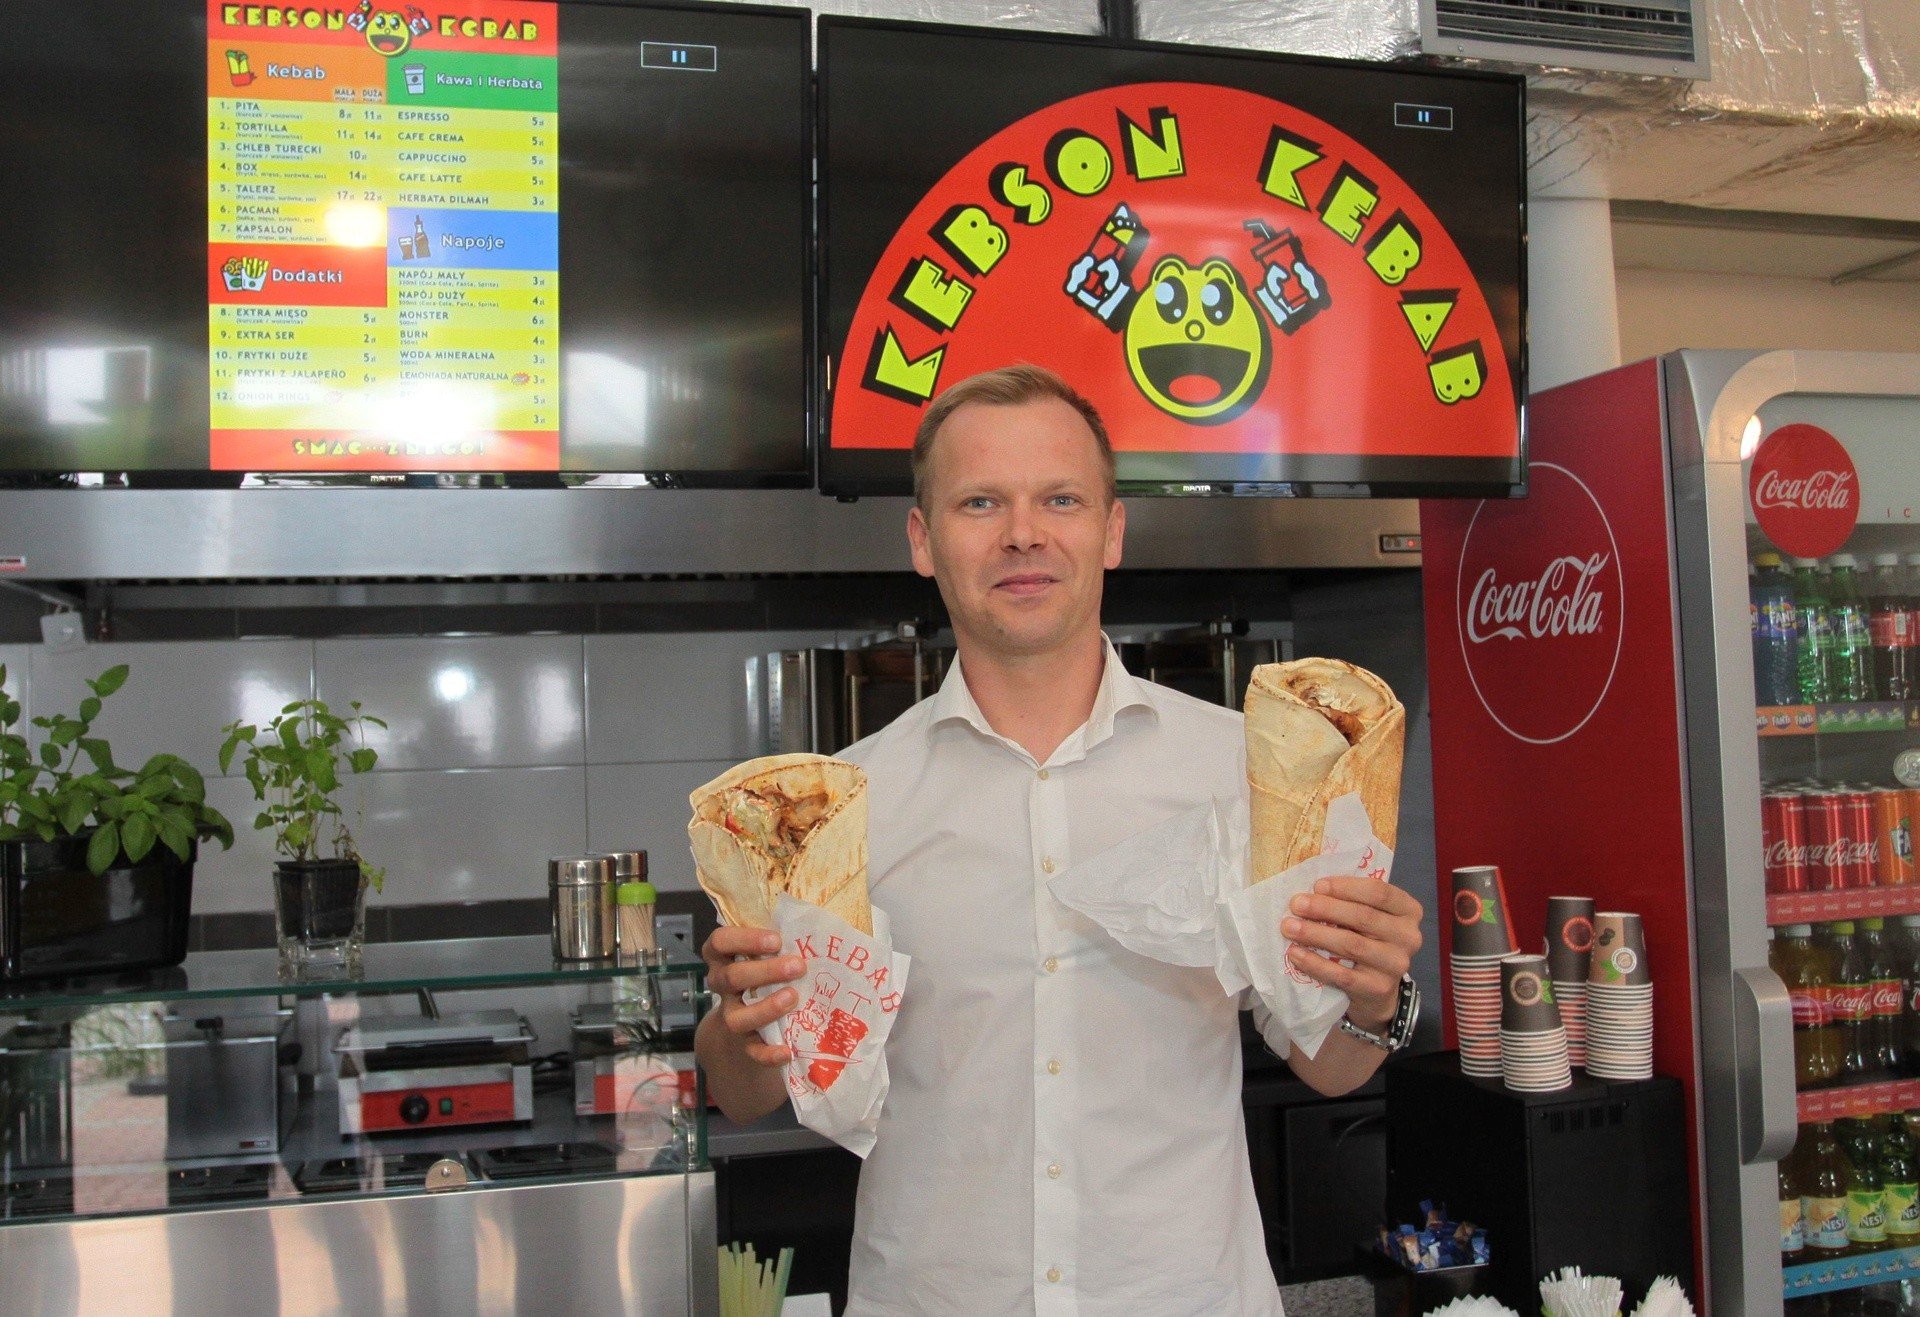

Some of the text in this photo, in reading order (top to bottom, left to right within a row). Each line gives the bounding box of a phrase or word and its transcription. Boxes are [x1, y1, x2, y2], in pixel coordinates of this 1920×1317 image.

[222, 3, 345, 31] KEBSON
[266, 63, 326, 80] Kebab
[436, 73, 543, 90] Kawa i Herbata
[220, 101, 260, 111] 1. PITA
[398, 111, 450, 122] ESPRESSO
[220, 121, 288, 132] 2. TORTILLA
[398, 132, 464, 143] CAFE CREMA
[220, 142, 322, 154] 3. CHLEB TURECKI
[398, 152, 467, 163] CAPPUCCINO
[220, 162, 257, 171] 4. BOX
[398, 173, 462, 183] CAFE LATTE
[220, 183, 275, 193] 5. TALERZ
[399, 194, 489, 204] HERBATA DILMAH
[220, 204, 280, 215] 6. PACMAN
[220, 223, 293, 233] 7. KAPSALON
[440, 233, 505, 250] Napoje
[860, 106, 1489, 407] KEBSON KEBAB
[272, 268, 343, 283] Dodatki
[398, 269, 465, 280] NAPÓJ MAŁY
[398, 289, 466, 300] NAPÓJ DUŻY
[220, 308, 308, 319] 8. EXTRA MIĘSO
[399, 311, 449, 320] MONSTER
[220, 330, 295, 340] 9. EXTRA SER
[400, 329, 428, 339] BURN
[216, 350, 308, 360] 10. FRYTKI DUŻE
[400, 350, 495, 360] WODA MINERALNA
[237, 369, 275, 378] FRYTKI
[280, 370, 286, 378] Z
[400, 371, 452, 380] LEMONIADA
[455, 372, 509, 381] NATURALNA
[216, 392, 232, 400] 12.
[1756, 469, 1853, 509] Coca-Cola
[1467, 551, 1611, 644] Coca-Cola
[794, 934, 902, 1014] KEBAB
